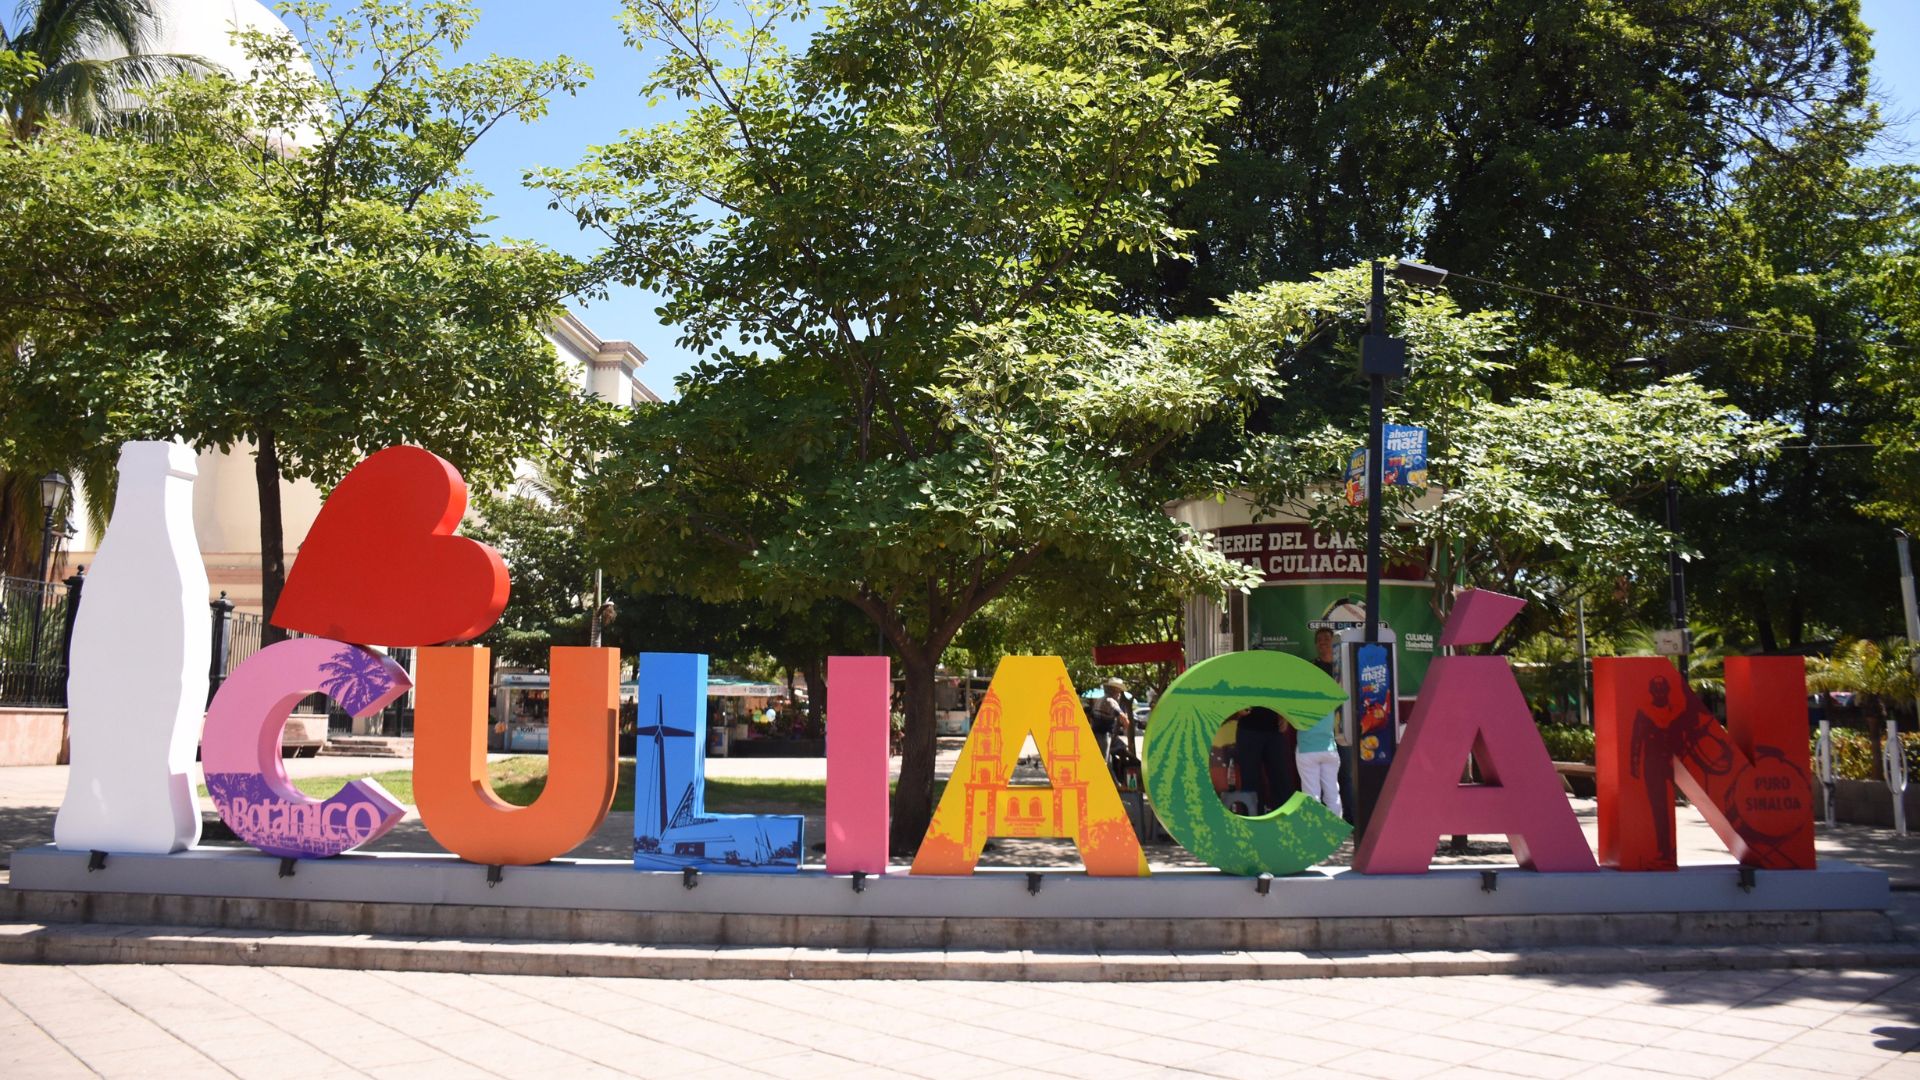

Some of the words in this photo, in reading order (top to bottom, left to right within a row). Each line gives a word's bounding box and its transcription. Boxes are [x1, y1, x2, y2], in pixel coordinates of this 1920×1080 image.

[1389, 429, 1418, 439] ahorra
[1213, 533, 1264, 554] SERIE
[1268, 531, 1308, 551] DEL
[202, 588, 1816, 877] CULIACÁN
[1754, 775, 1792, 791] PURO
[1745, 796, 1802, 812] SINALOA
